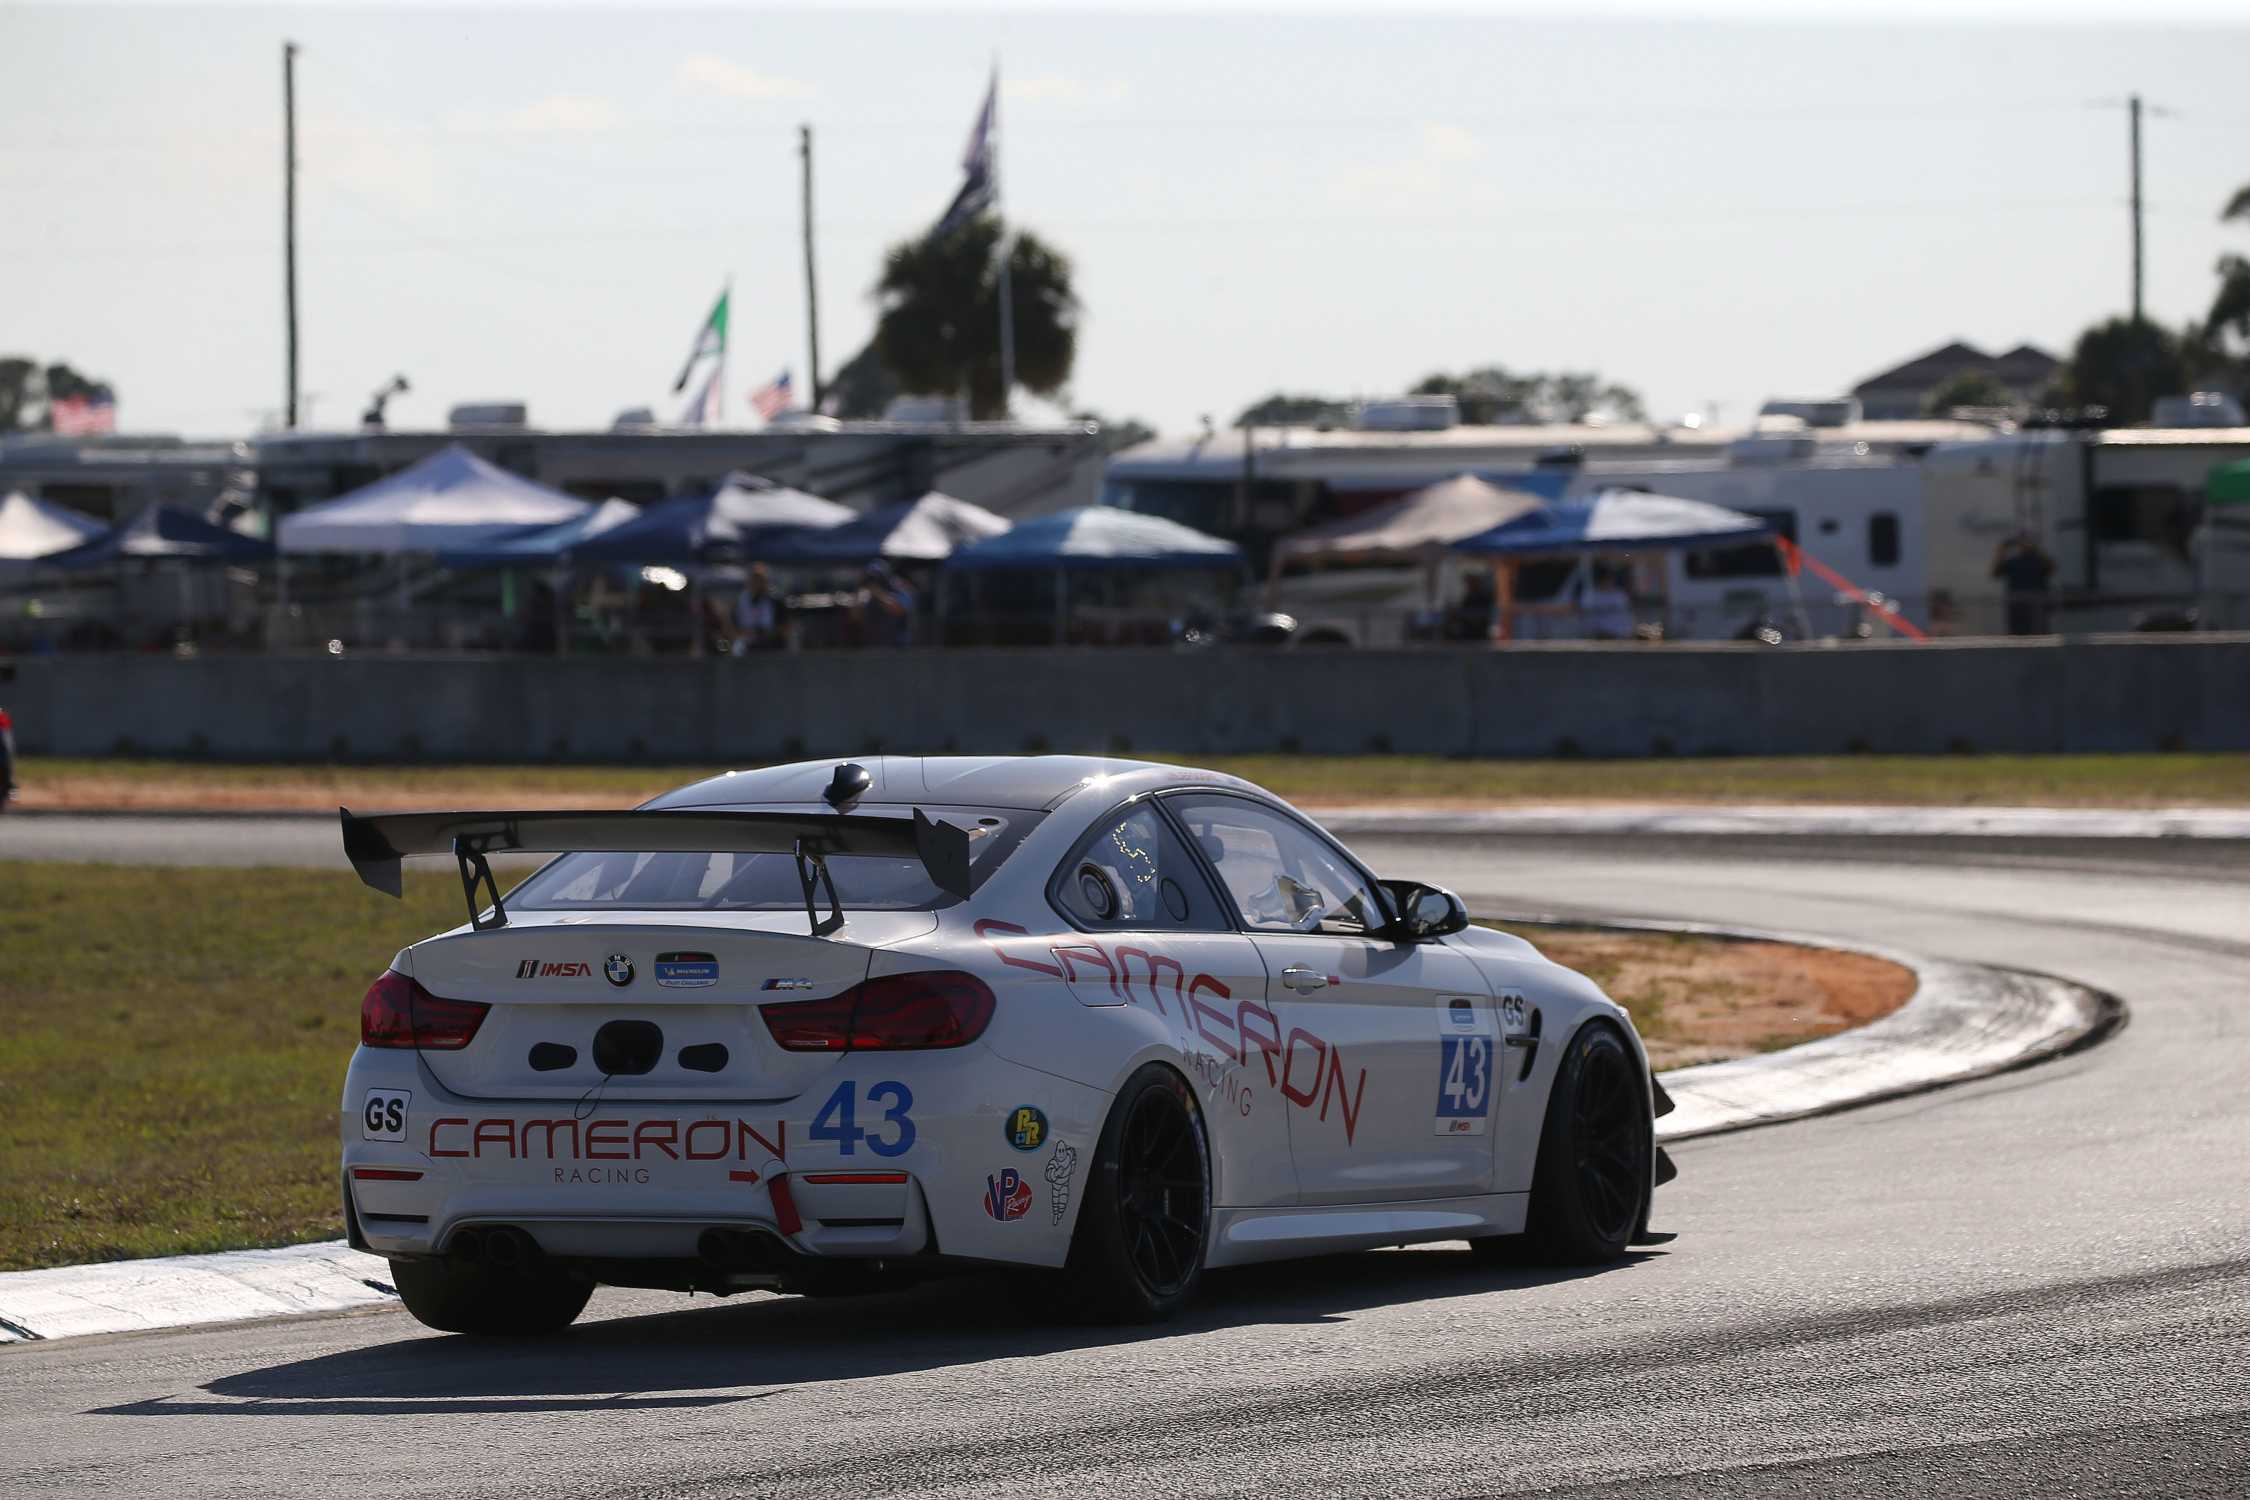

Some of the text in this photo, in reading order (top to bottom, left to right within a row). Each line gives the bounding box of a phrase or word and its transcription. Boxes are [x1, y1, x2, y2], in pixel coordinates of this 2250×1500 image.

[540, 962, 592, 977] IMSA
[974, 918, 1367, 1146] CAMERON
[1503, 994, 1524, 1027] GS
[1181, 1036, 1252, 1117] RACING
[1445, 1037, 1486, 1110] 43
[365, 1097, 404, 1133] GS
[808, 1080, 917, 1157] 43
[430, 1118, 785, 1161] CAMERON
[554, 1167, 650, 1184] RACING
[987, 1168, 1020, 1221] VP
